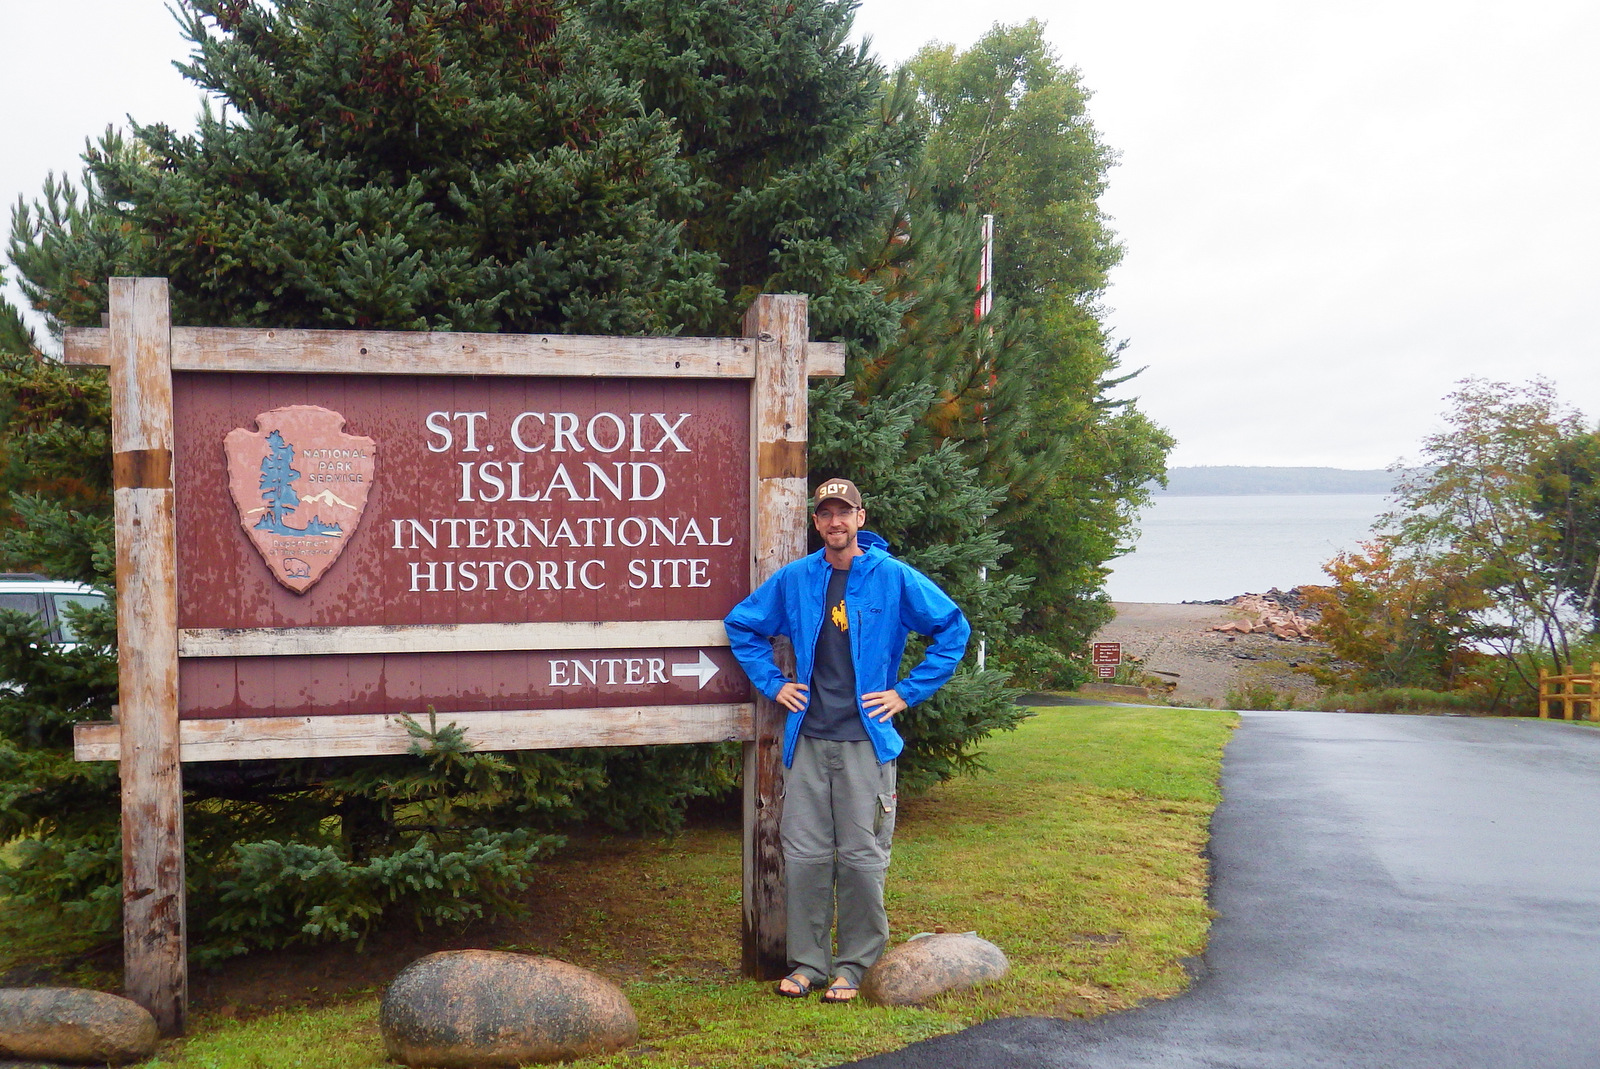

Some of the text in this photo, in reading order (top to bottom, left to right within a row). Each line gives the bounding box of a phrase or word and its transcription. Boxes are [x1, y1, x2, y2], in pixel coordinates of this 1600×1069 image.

[425, 411, 692, 453] ST. CROIX
[302, 449, 367, 459] NATIONAL
[319, 461, 352, 471] PARK
[309, 473, 363, 483] SERVICE
[457, 461, 666, 502] ISLAND
[391, 517, 733, 549] INTERNATIONAL
[408, 558, 712, 592] HISTORIC SITE
[548, 658, 670, 687] ENTER
